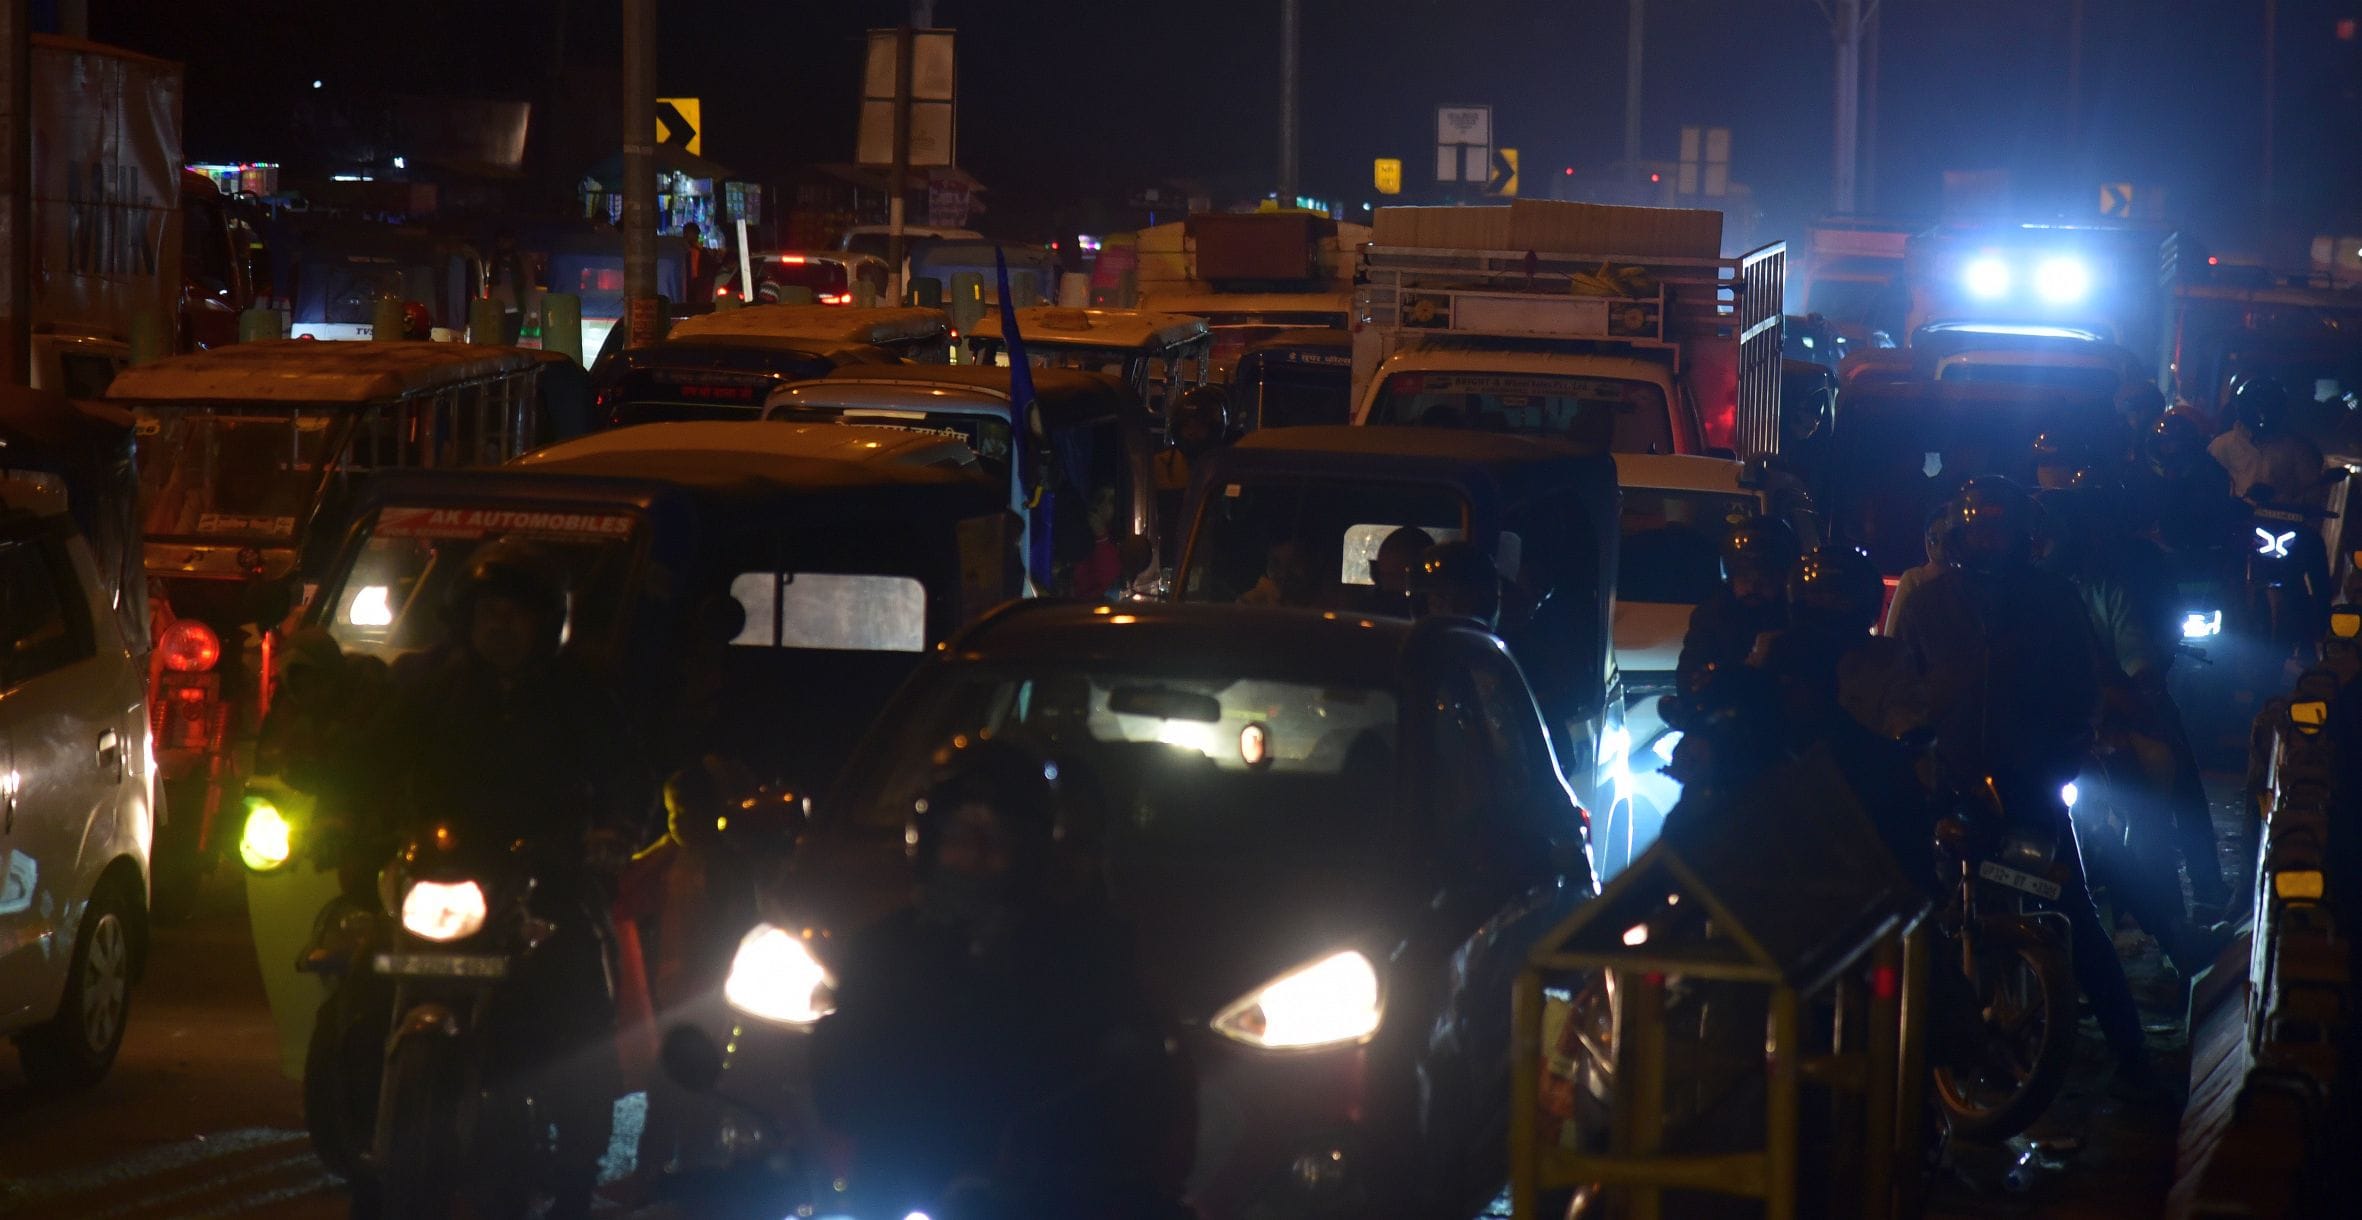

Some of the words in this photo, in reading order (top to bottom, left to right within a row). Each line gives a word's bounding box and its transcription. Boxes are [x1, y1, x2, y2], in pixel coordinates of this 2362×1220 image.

[1455, 377, 1490, 386] BRIGHT
[428, 510, 462, 525] AK
[466, 510, 631, 532] AUTOMOBILES
